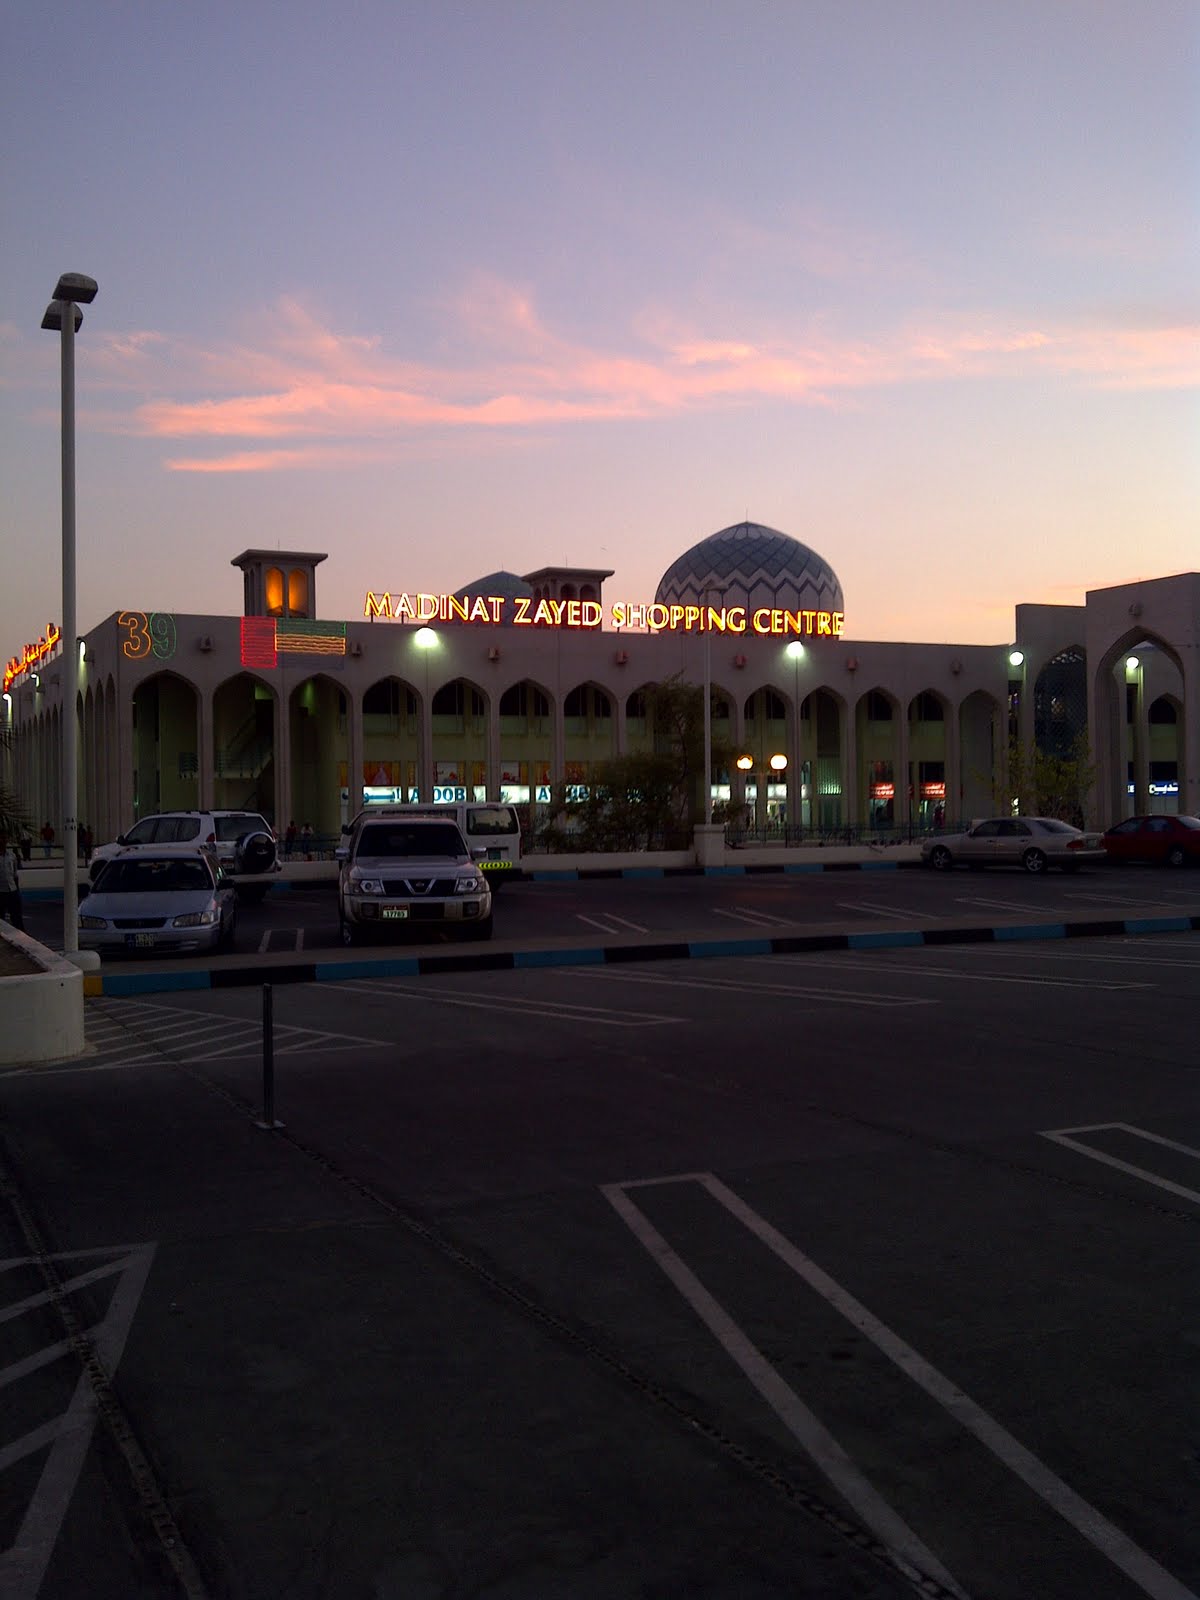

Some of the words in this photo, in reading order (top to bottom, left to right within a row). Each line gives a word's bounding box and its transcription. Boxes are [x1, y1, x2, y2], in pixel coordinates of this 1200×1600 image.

[364, 591, 504, 622] MADINAT
[513, 597, 602, 626] ZAYED
[611, 601, 746, 632] SHOPPING
[752, 608, 845, 636] CENTRE
